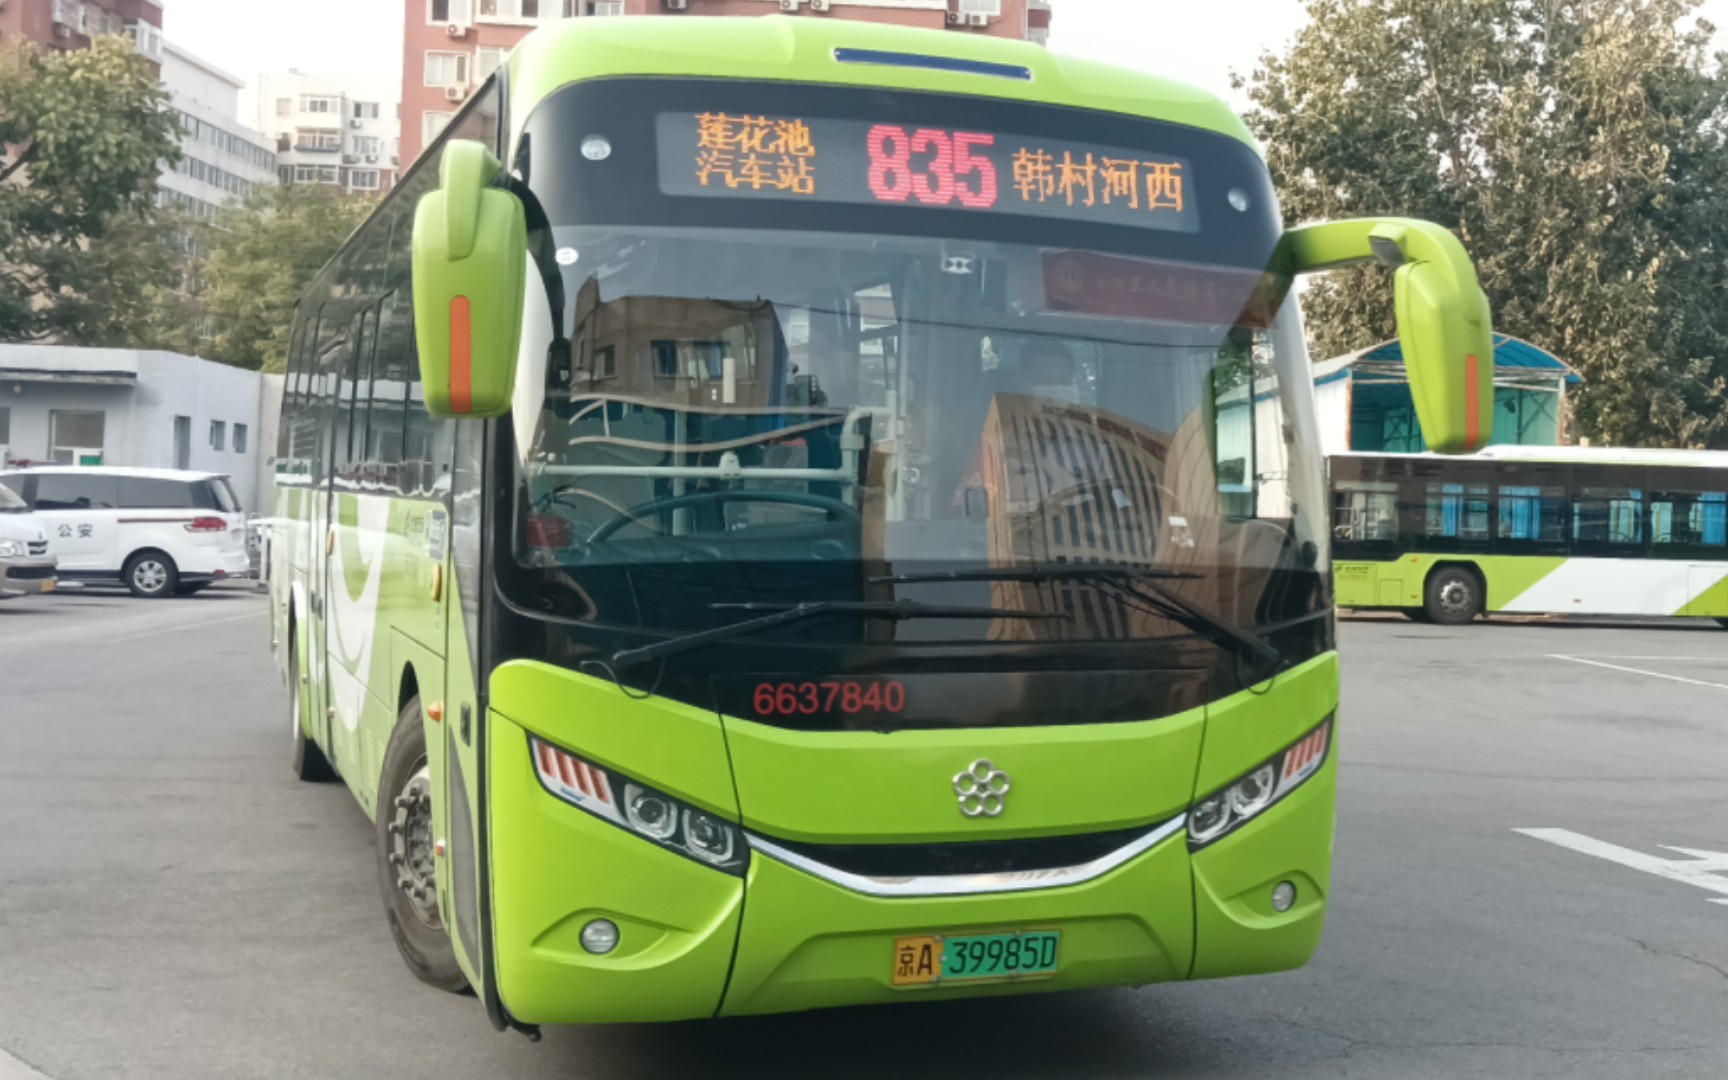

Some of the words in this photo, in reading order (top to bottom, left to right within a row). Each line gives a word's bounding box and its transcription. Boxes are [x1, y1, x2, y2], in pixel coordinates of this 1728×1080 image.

[695, 112, 815, 156] 莲花池
[695, 150, 815, 194] 汽车站
[867, 124, 997, 208] 835
[1012, 147, 1183, 212] 韩村河西
[57, 523, 94, 539] 公安
[753, 680, 905, 715] 6637840
